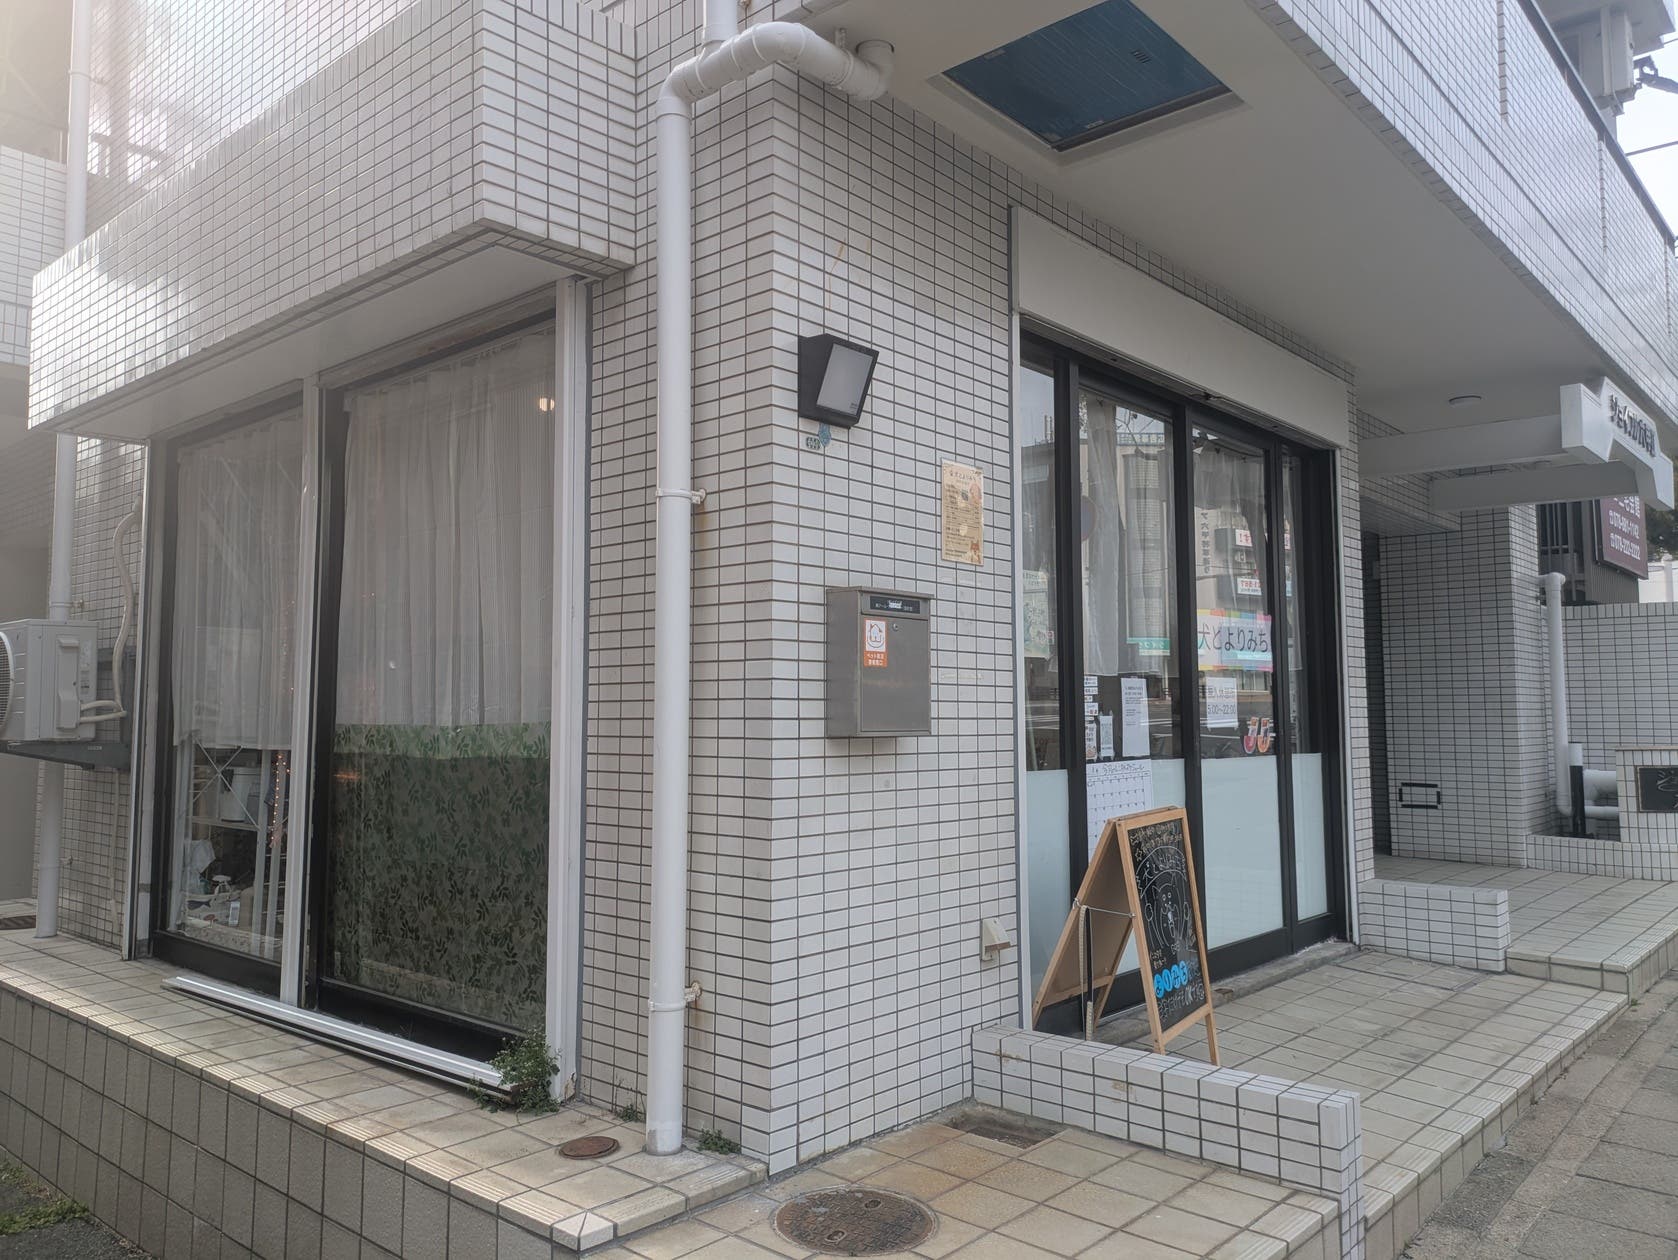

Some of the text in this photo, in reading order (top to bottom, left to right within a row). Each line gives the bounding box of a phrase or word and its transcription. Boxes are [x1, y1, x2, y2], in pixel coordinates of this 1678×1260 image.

[1198, 622, 1269, 653] 犬とよりみち
